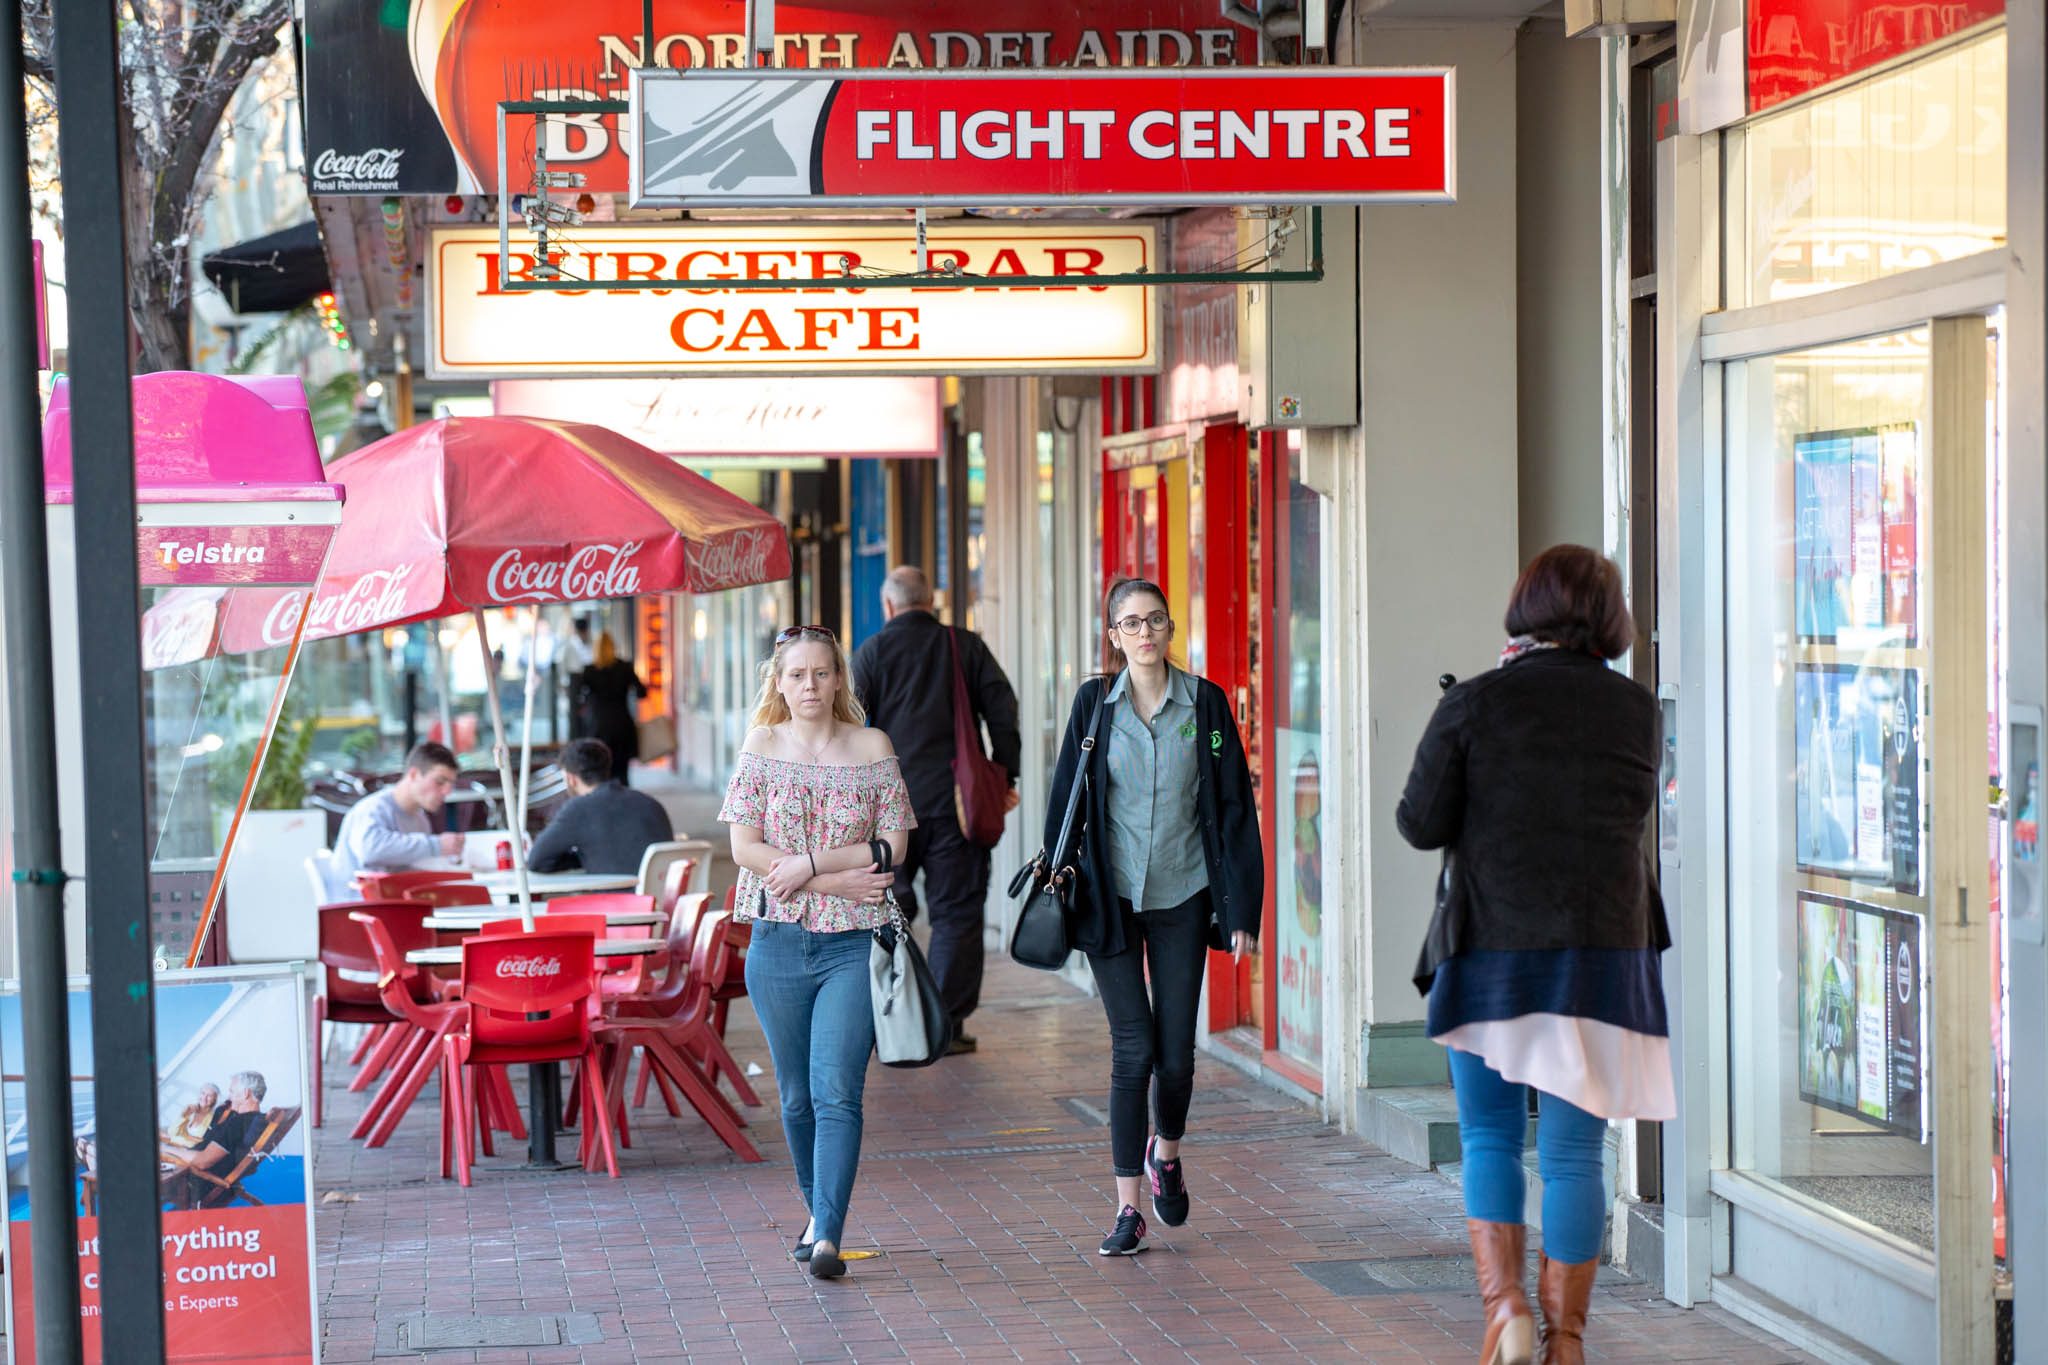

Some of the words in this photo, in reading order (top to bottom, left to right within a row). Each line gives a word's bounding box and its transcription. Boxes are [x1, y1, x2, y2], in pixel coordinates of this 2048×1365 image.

[856, 109, 1116, 160] FLIGHT
[1127, 107, 1411, 160] CENTRE
[313, 148, 405, 181] Coca-Cola
[313, 181, 336, 190] Real
[338, 181, 399, 190] Refreshment
[476, 250, 868, 296] BURGER
[911, 248, 1110, 292] BAR
[670, 307, 920, 352] CAFE
[159, 542, 266, 565] Telstra
[486, 540, 645, 602] Coca-Cola
[496, 955, 561, 978] Coca-Cola
[176, 1255, 277, 1283] control
[179, 1295, 239, 1313] Experts
